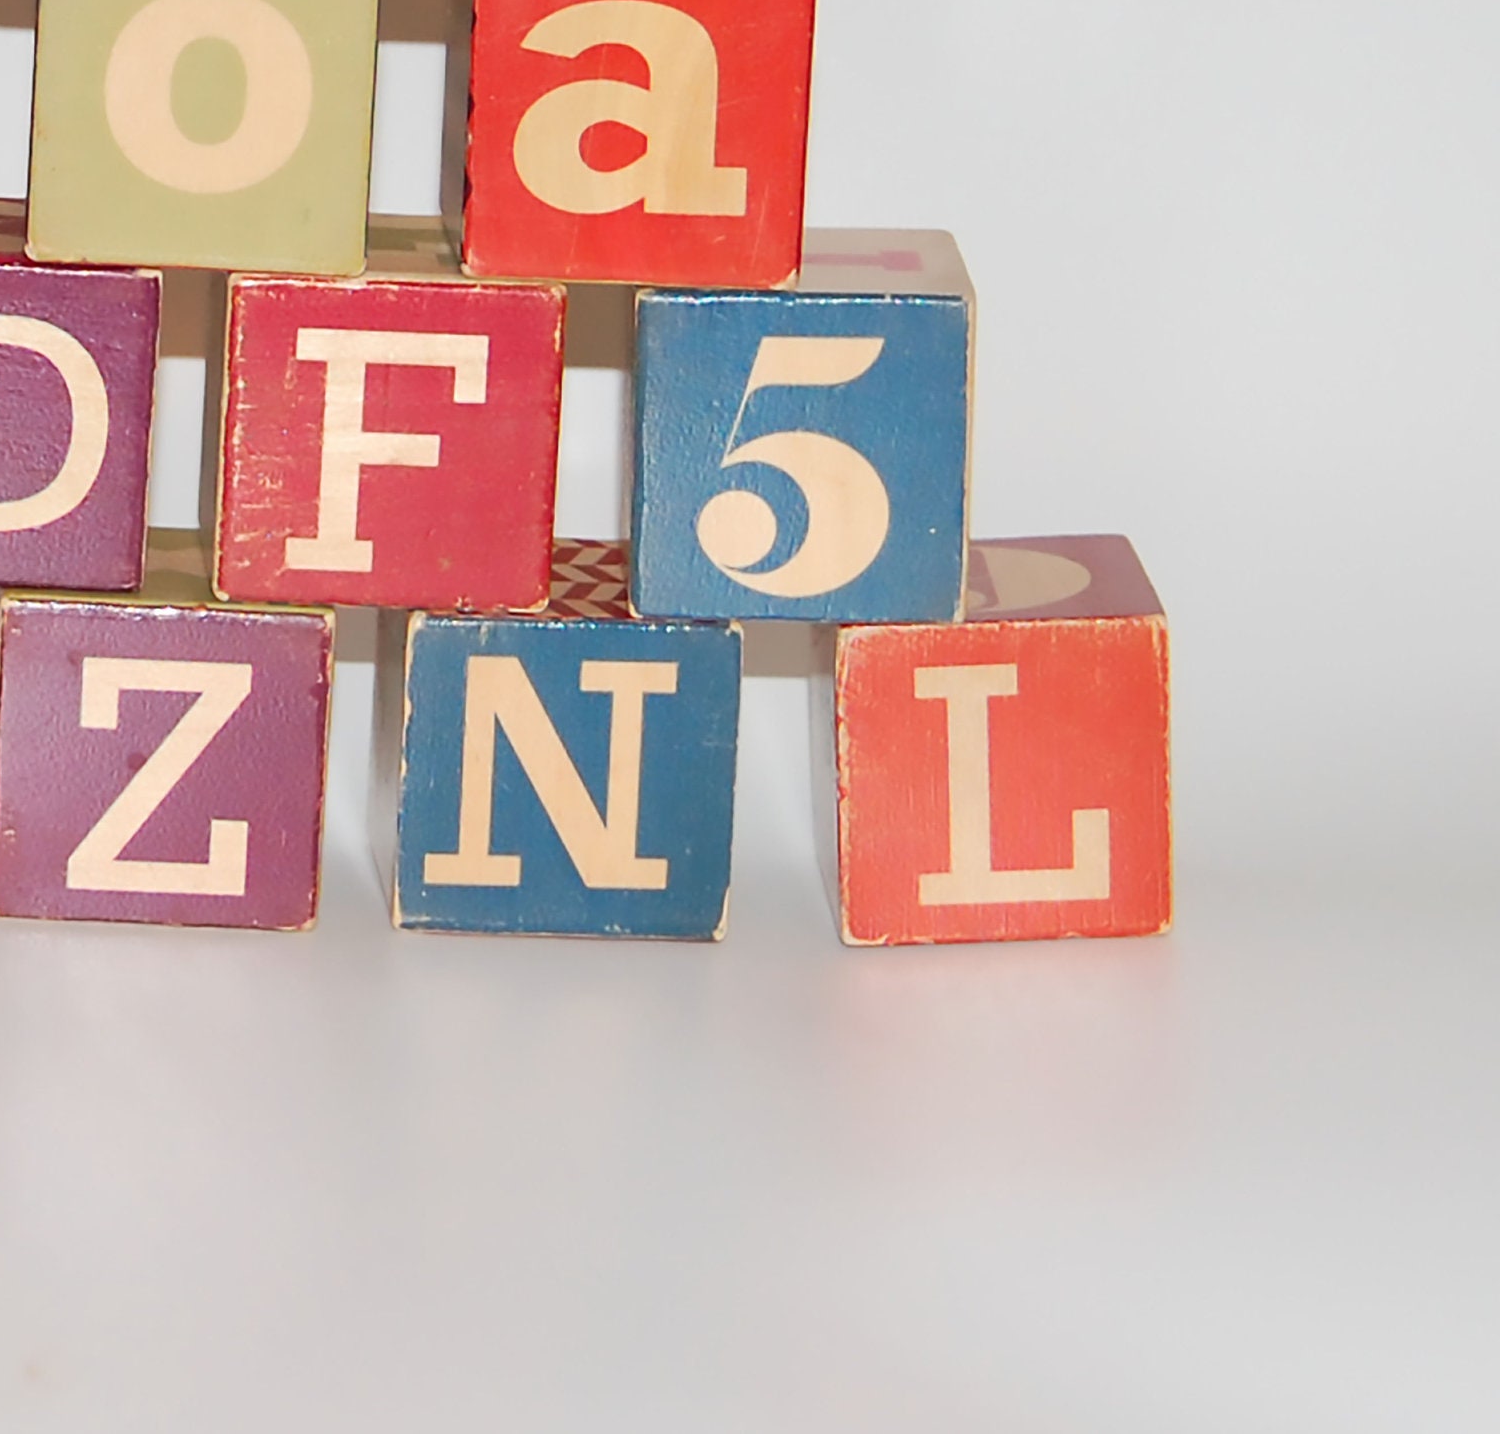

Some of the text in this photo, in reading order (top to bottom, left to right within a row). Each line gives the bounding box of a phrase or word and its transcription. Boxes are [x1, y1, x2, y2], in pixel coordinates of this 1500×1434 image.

[283, 327, 490, 573] F
[696, 336, 891, 598] 5
[423, 655, 679, 890] N
[913, 662, 1111, 906] L
